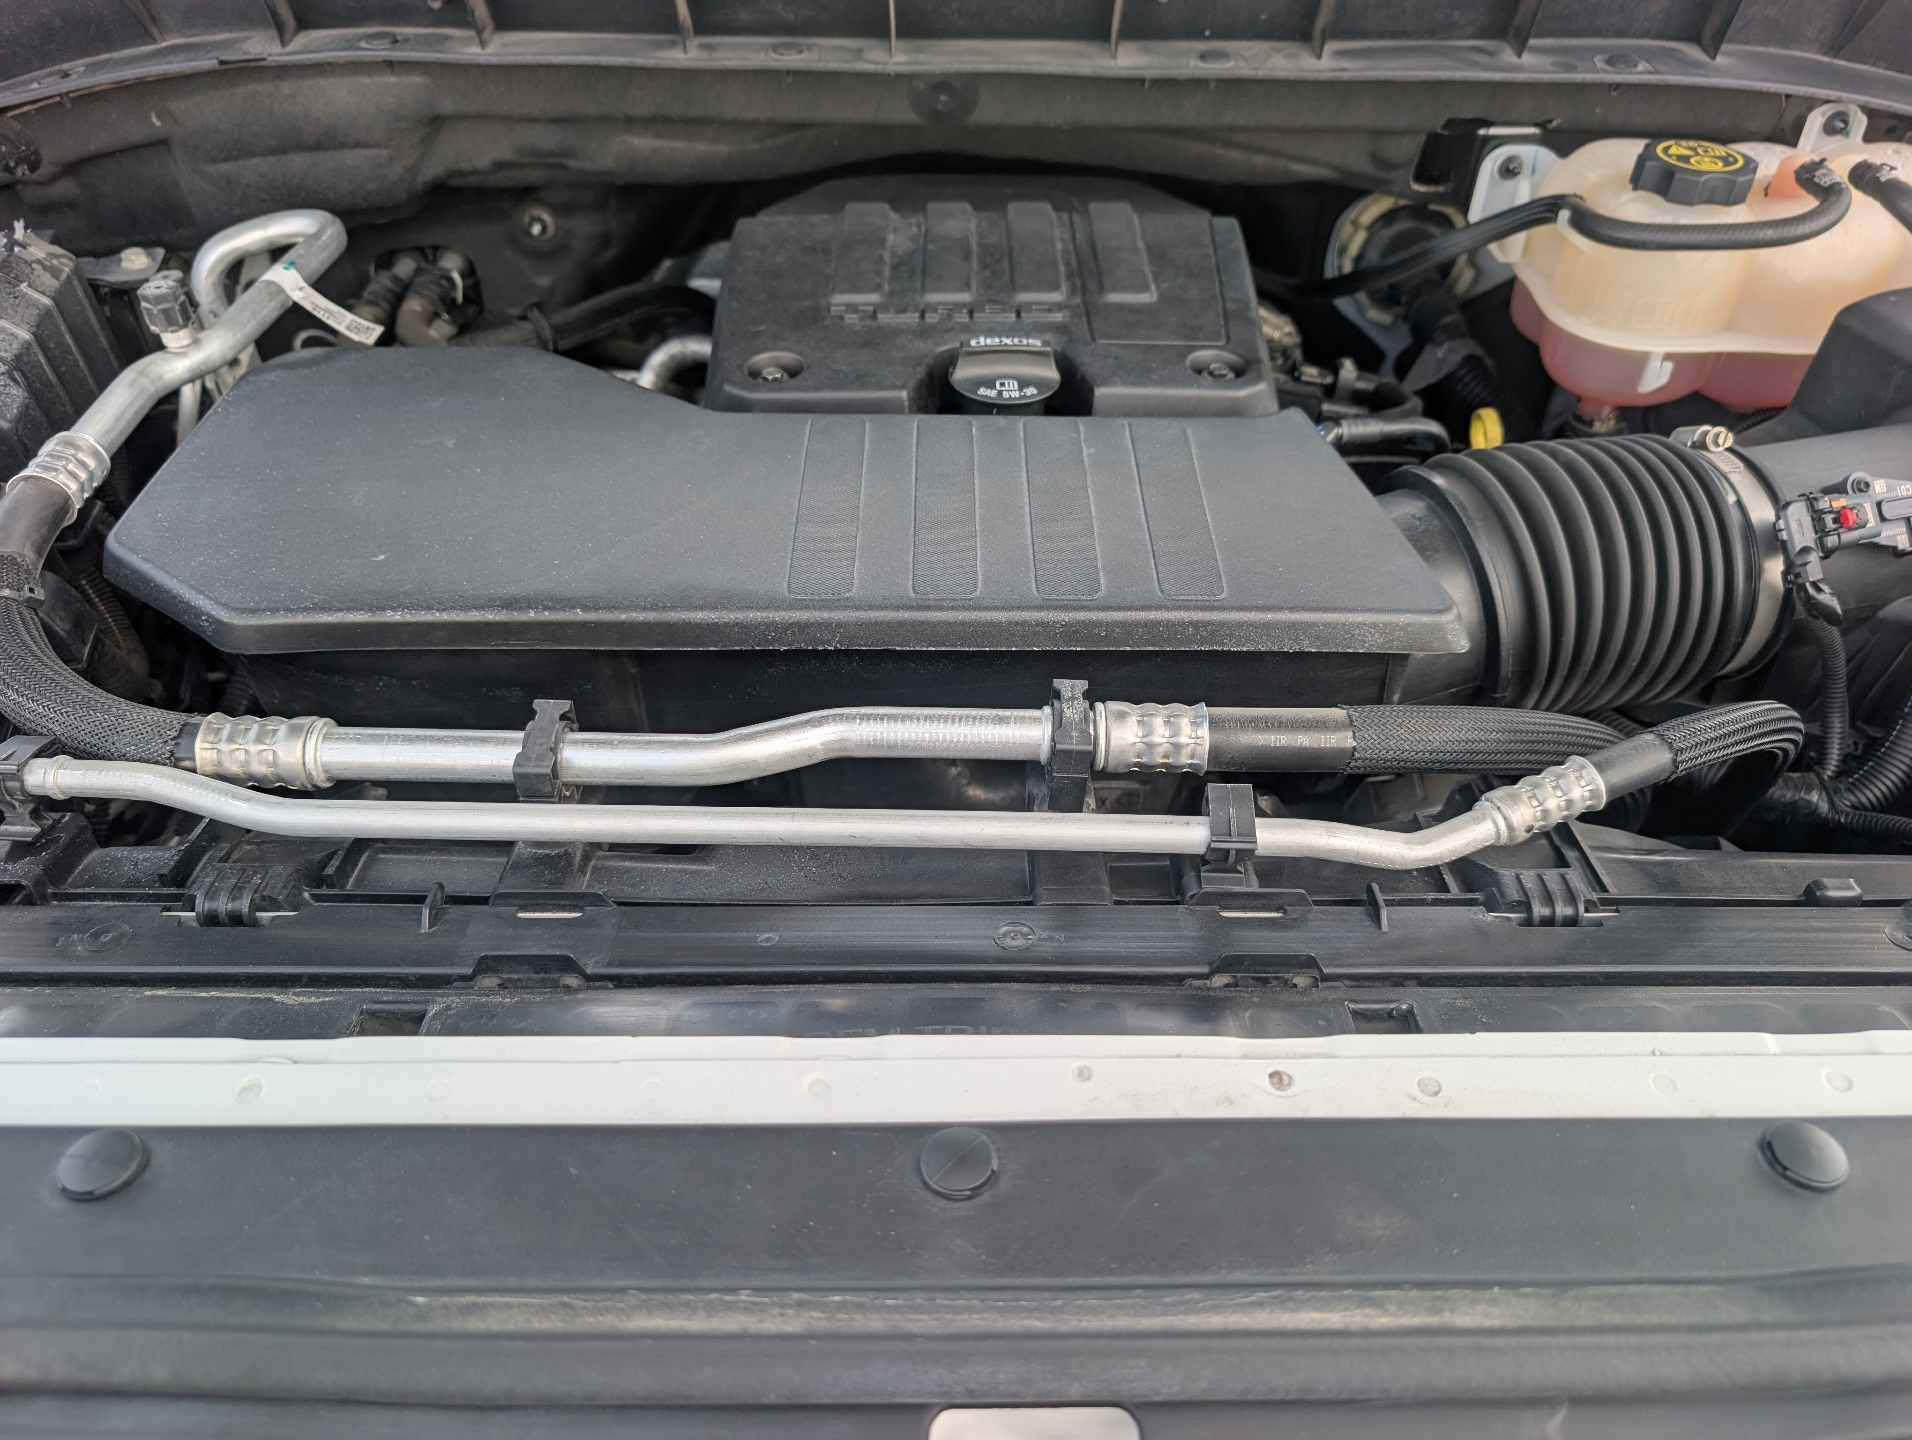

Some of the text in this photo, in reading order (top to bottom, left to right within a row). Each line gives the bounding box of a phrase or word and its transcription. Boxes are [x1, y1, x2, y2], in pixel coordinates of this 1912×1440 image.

[970, 335, 1042, 347] dexos
[977, 387, 1038, 398] SAE 5W-30
[1297, 735, 1309, 747] PA
